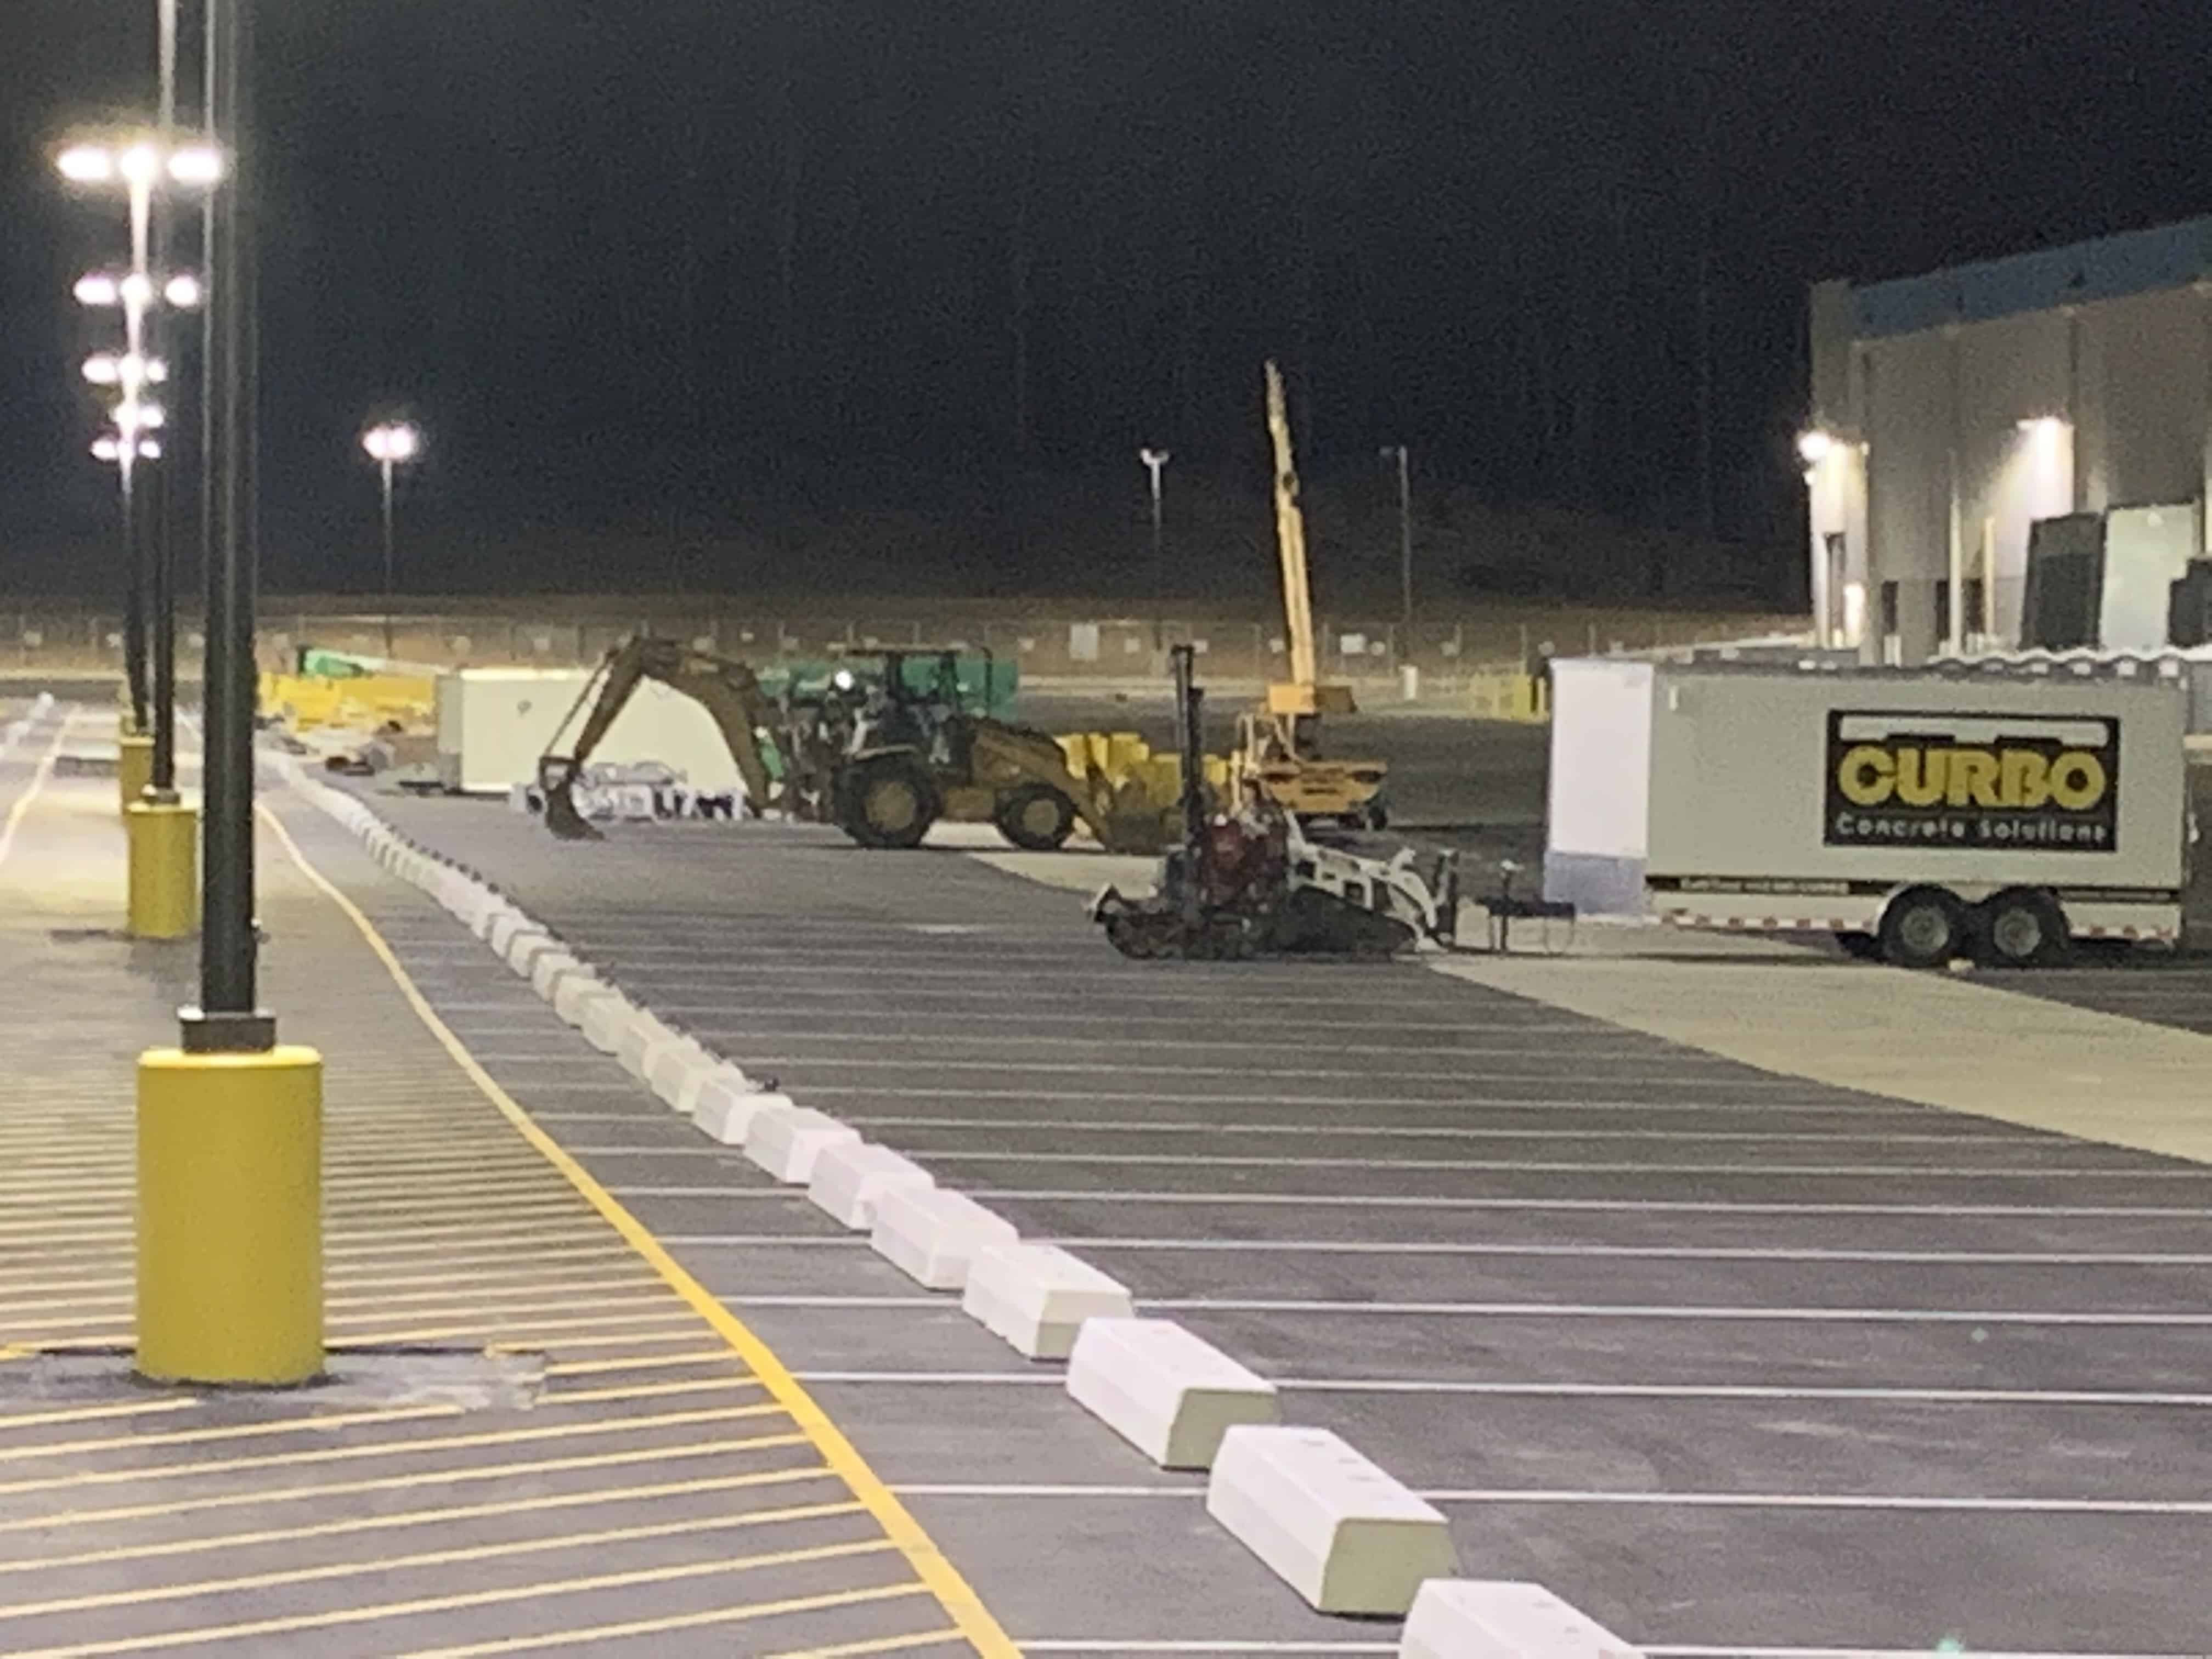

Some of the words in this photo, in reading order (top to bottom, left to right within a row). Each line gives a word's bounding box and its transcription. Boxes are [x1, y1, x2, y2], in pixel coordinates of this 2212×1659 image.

[1837, 744, 2106, 810] CURBO
[1836, 812, 1965, 838] Concrete
[1979, 819, 2107, 842] Solutions
